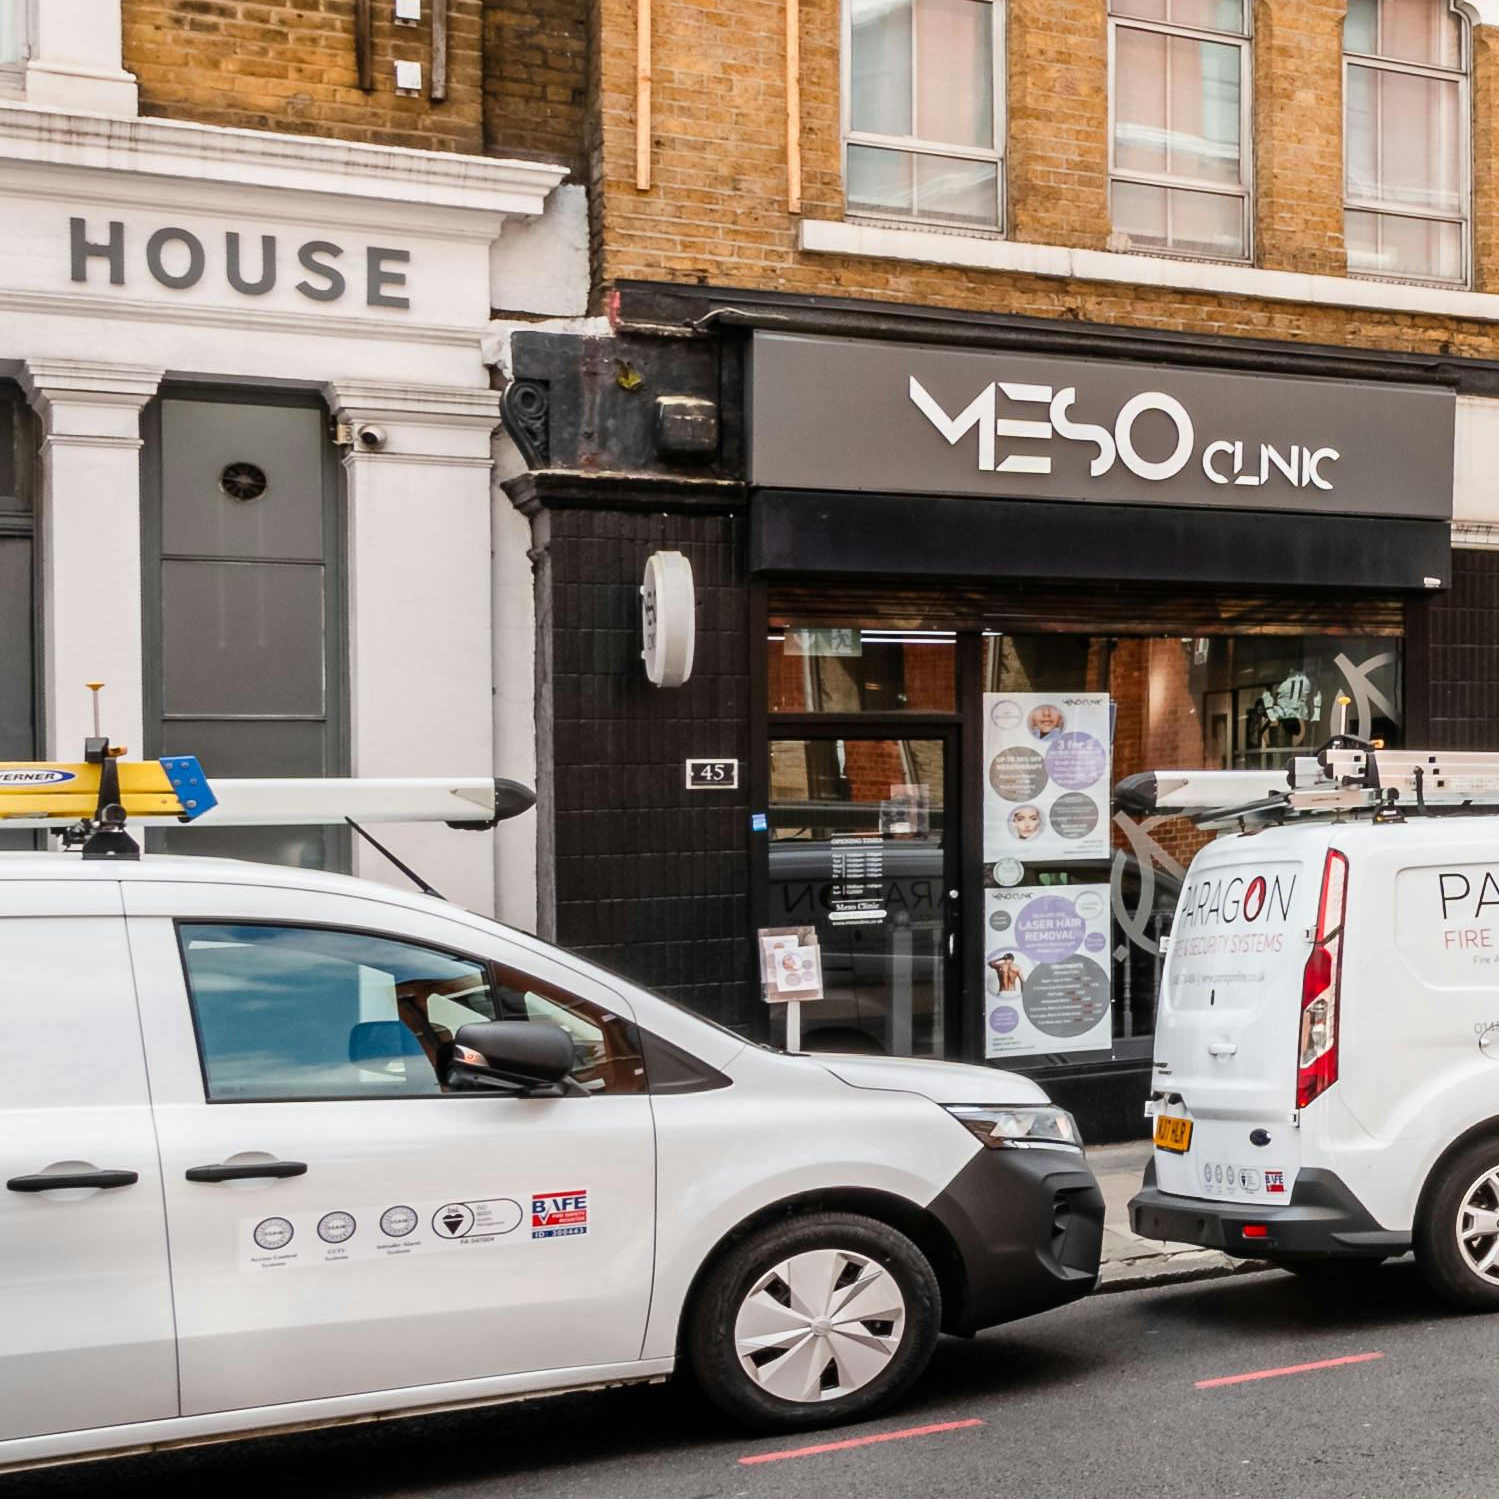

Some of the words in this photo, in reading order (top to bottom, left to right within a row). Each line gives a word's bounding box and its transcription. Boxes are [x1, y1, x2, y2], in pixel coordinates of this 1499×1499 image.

[70, 217, 411, 309] HOUSE
[909, 375, 1195, 481] MESO
[1202, 439, 1341, 490] CLINIC
[1057, 741, 1065, 750] 3
[1067, 740, 1084, 750] for
[700, 764, 725, 781] 45
[1018, 919, 1054, 931] LASER
[1055, 917, 1082, 928] HAIR
[1024, 930, 1076, 942] REMOVAL
[1444, 928, 1493, 950] FIRE
[1473, 955, 1491, 964] Fire
